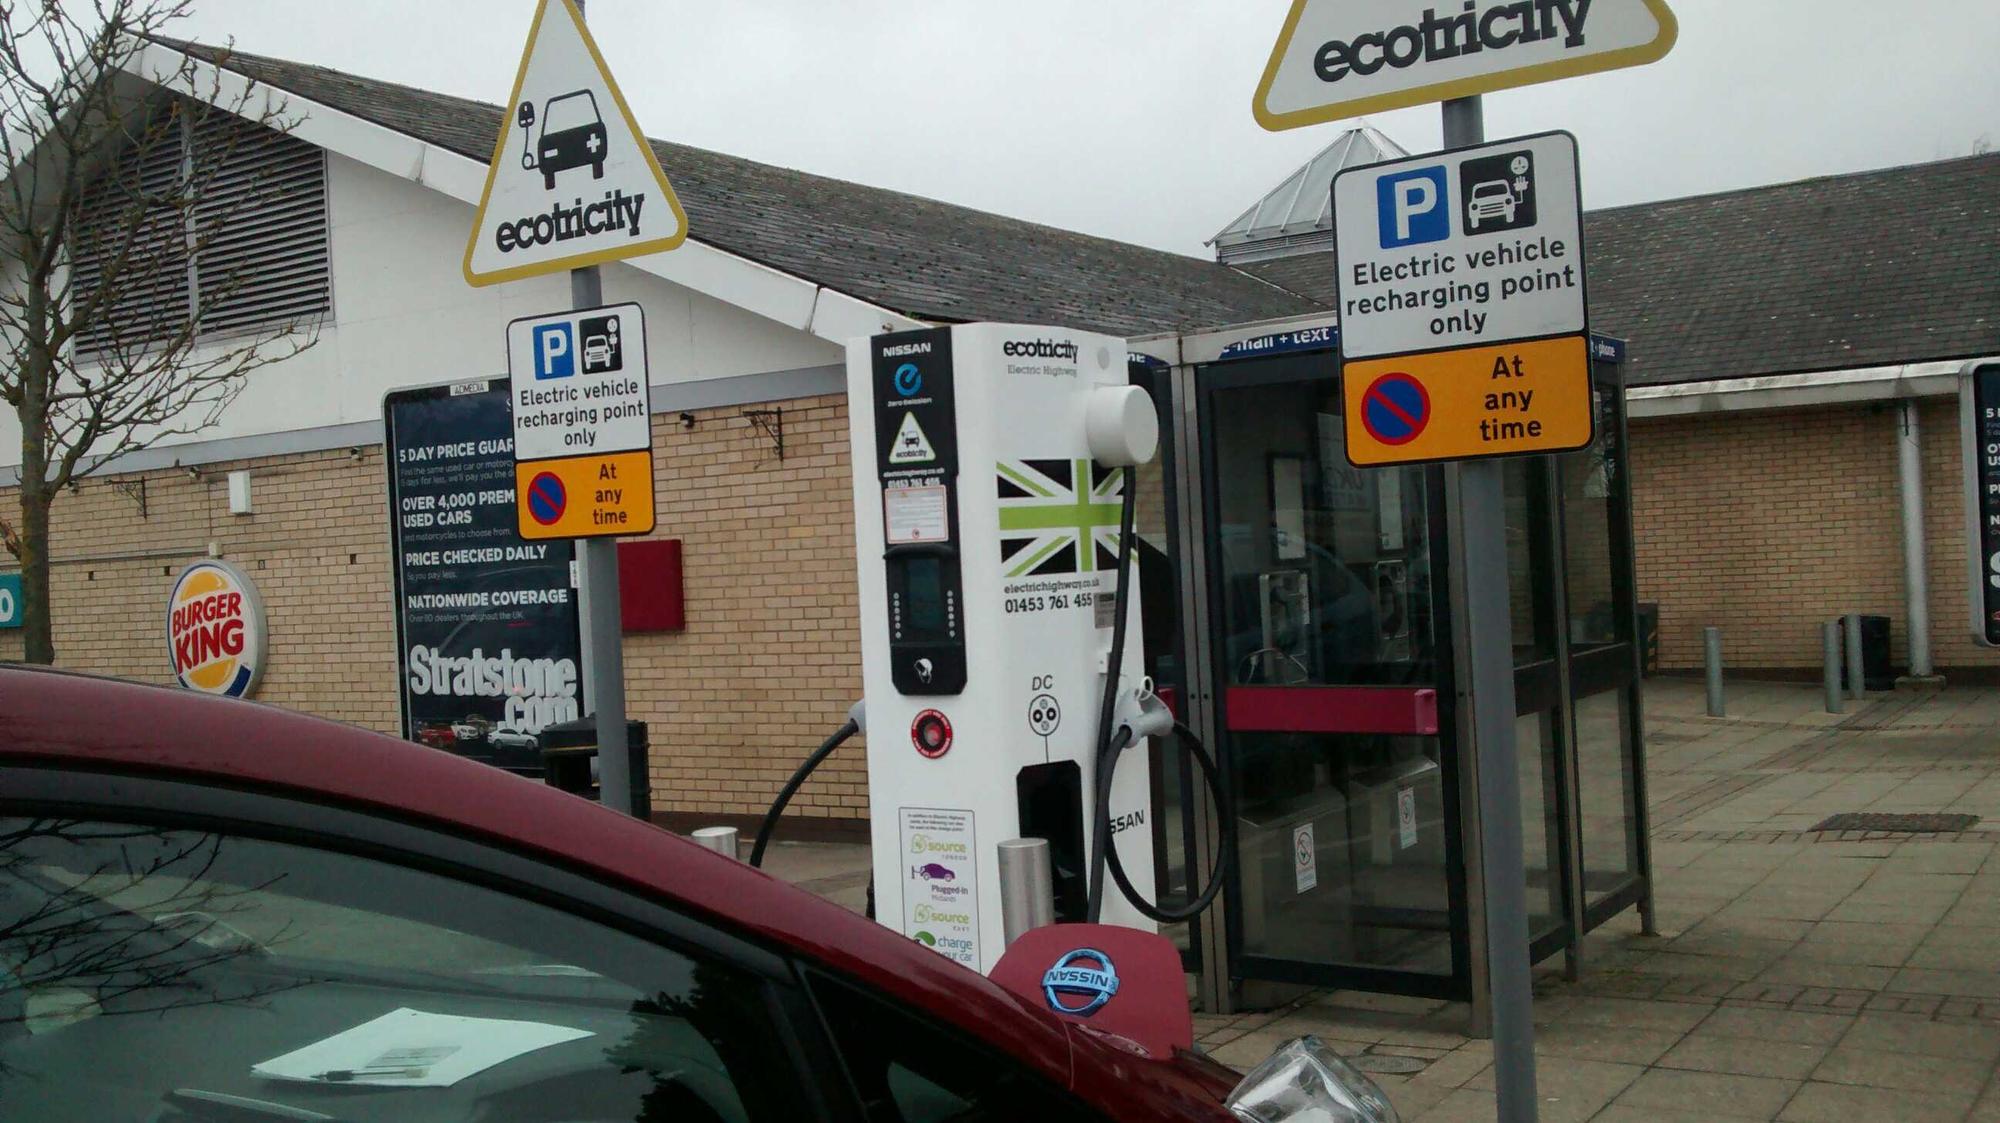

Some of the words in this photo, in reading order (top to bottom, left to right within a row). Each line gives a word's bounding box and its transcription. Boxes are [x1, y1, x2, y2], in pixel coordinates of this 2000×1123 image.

[1313, 0, 1592, 83] ecotricity
[1394, 177, 1437, 240] P
[496, 189, 645, 252] ecotricity
[1353, 252, 1456, 286] Electric
[1465, 236, 1565, 270] vehicle
[1347, 281, 1490, 316] recharging
[1501, 265, 1575, 300] point
[1429, 309, 1487, 335] only
[541, 328, 567, 375] P
[882, 342, 932, 357] NISSAN
[1003, 338, 1079, 364] ecotricity
[1007, 364, 1041, 375] Electric
[1491, 354, 1525, 380] At
[520, 387, 579, 407] Electric
[583, 379, 639, 400] vehicle
[1484, 388, 1534, 412] any
[517, 408, 599, 429] recharging
[603, 400, 645, 425] point
[564, 428, 597, 447] only
[1479, 418, 1542, 441] time
[400, 449, 406, 463] 5
[408, 446, 435, 462] DAY
[437, 442, 475, 459] PRICE
[598, 463, 617, 481] At
[403, 496, 435, 511] OVER
[438, 492, 475, 510] 4,000
[595, 488, 622, 505] any
[403, 514, 433, 528] USED
[437, 510, 473, 525] CARS
[592, 508, 628, 525] time
[406, 552, 440, 566] PRICE
[443, 548, 502, 564] CHECKED
[506, 545, 547, 560] DAILY
[1004, 578, 1100, 593] electrichighway.co.uk
[408, 593, 488, 608] NATIONWIDE
[491, 589, 567, 606] COVERAGE
[1005, 596, 1044, 613] 01453
[1049, 595, 1069, 610] 761
[1073, 592, 1092, 608] 455
[172, 591, 242, 638] BURGER
[175, 619, 244, 677] KING
[409, 644, 577, 698] Stratstone
[1032, 675, 1053, 691] DC
[931, 912, 969, 924] source
[938, 936, 973, 953] charge
[959, 953, 972, 961] car
[1048, 970, 1109, 989] NISSAN
